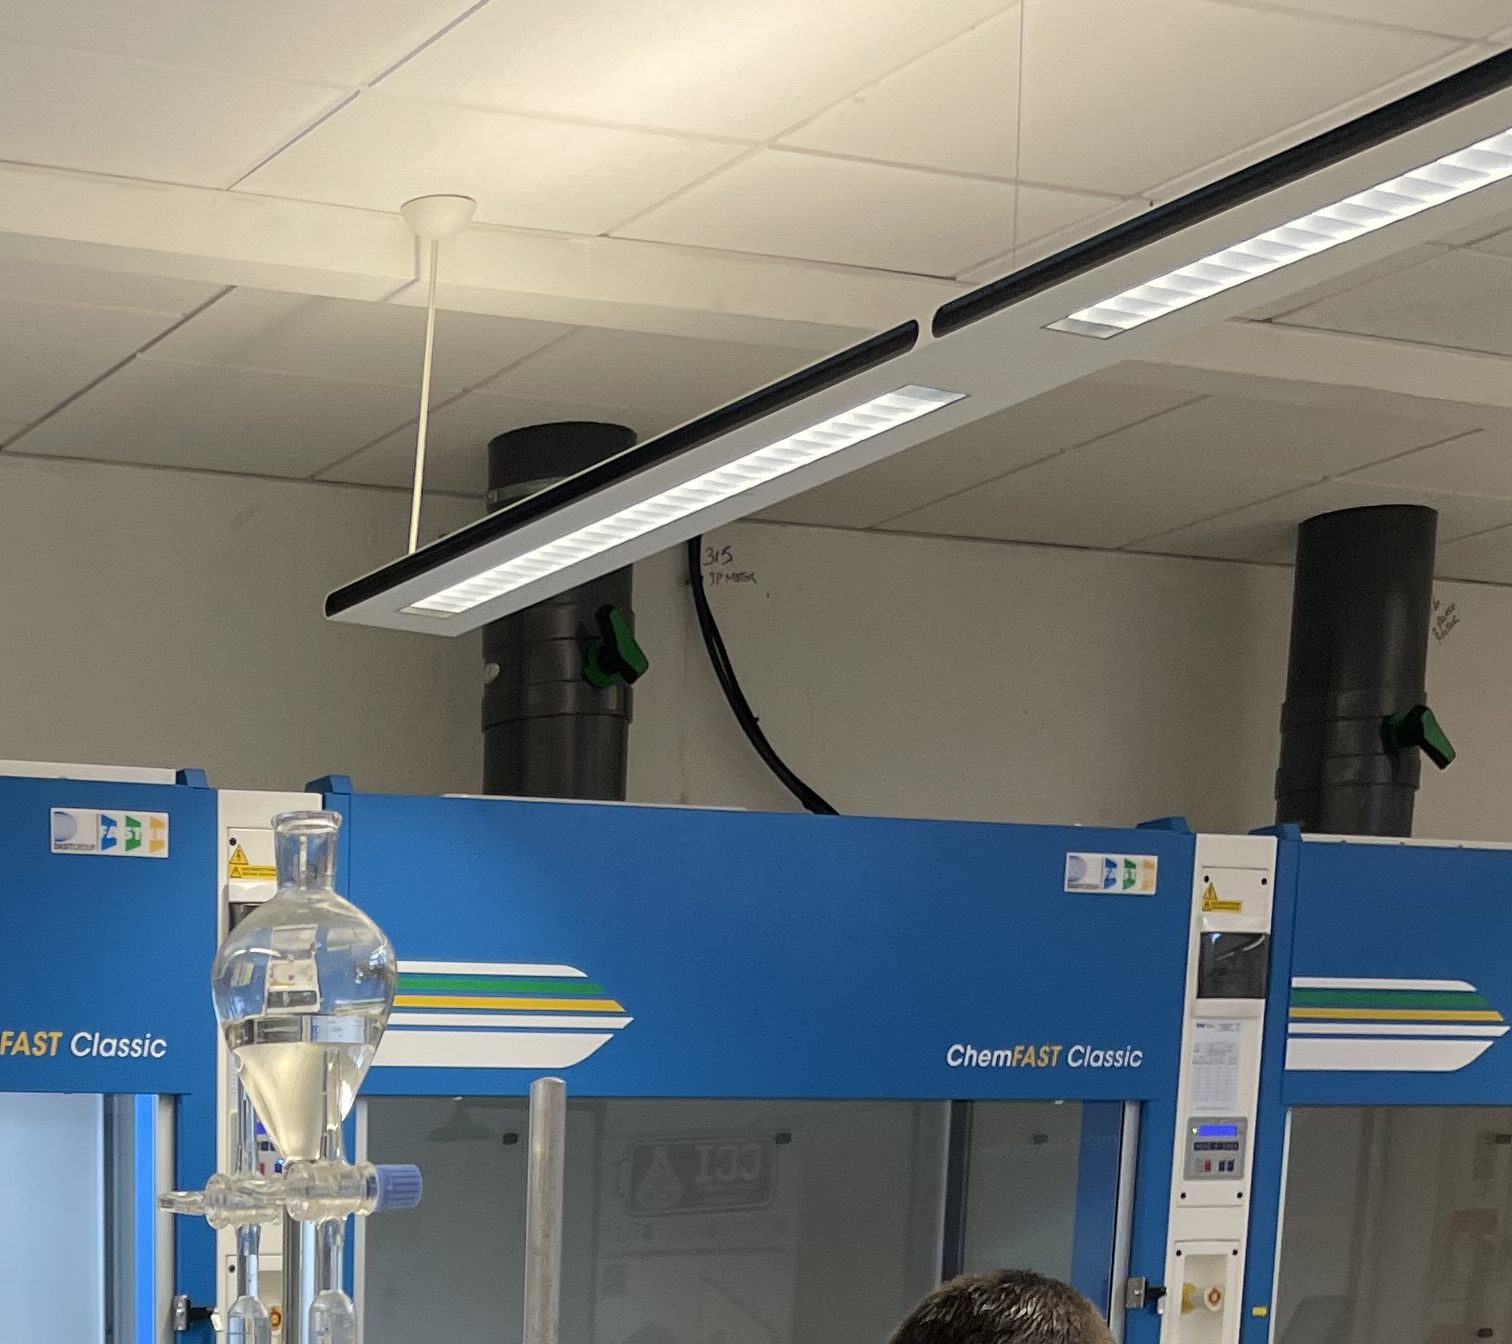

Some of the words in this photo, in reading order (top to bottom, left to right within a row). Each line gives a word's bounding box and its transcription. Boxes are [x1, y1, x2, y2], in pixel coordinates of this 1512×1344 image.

[70, 1031, 168, 1058] Classic
[946, 1043, 1063, 1068] ChemFAST
[1067, 1044, 1144, 1068] Classic
